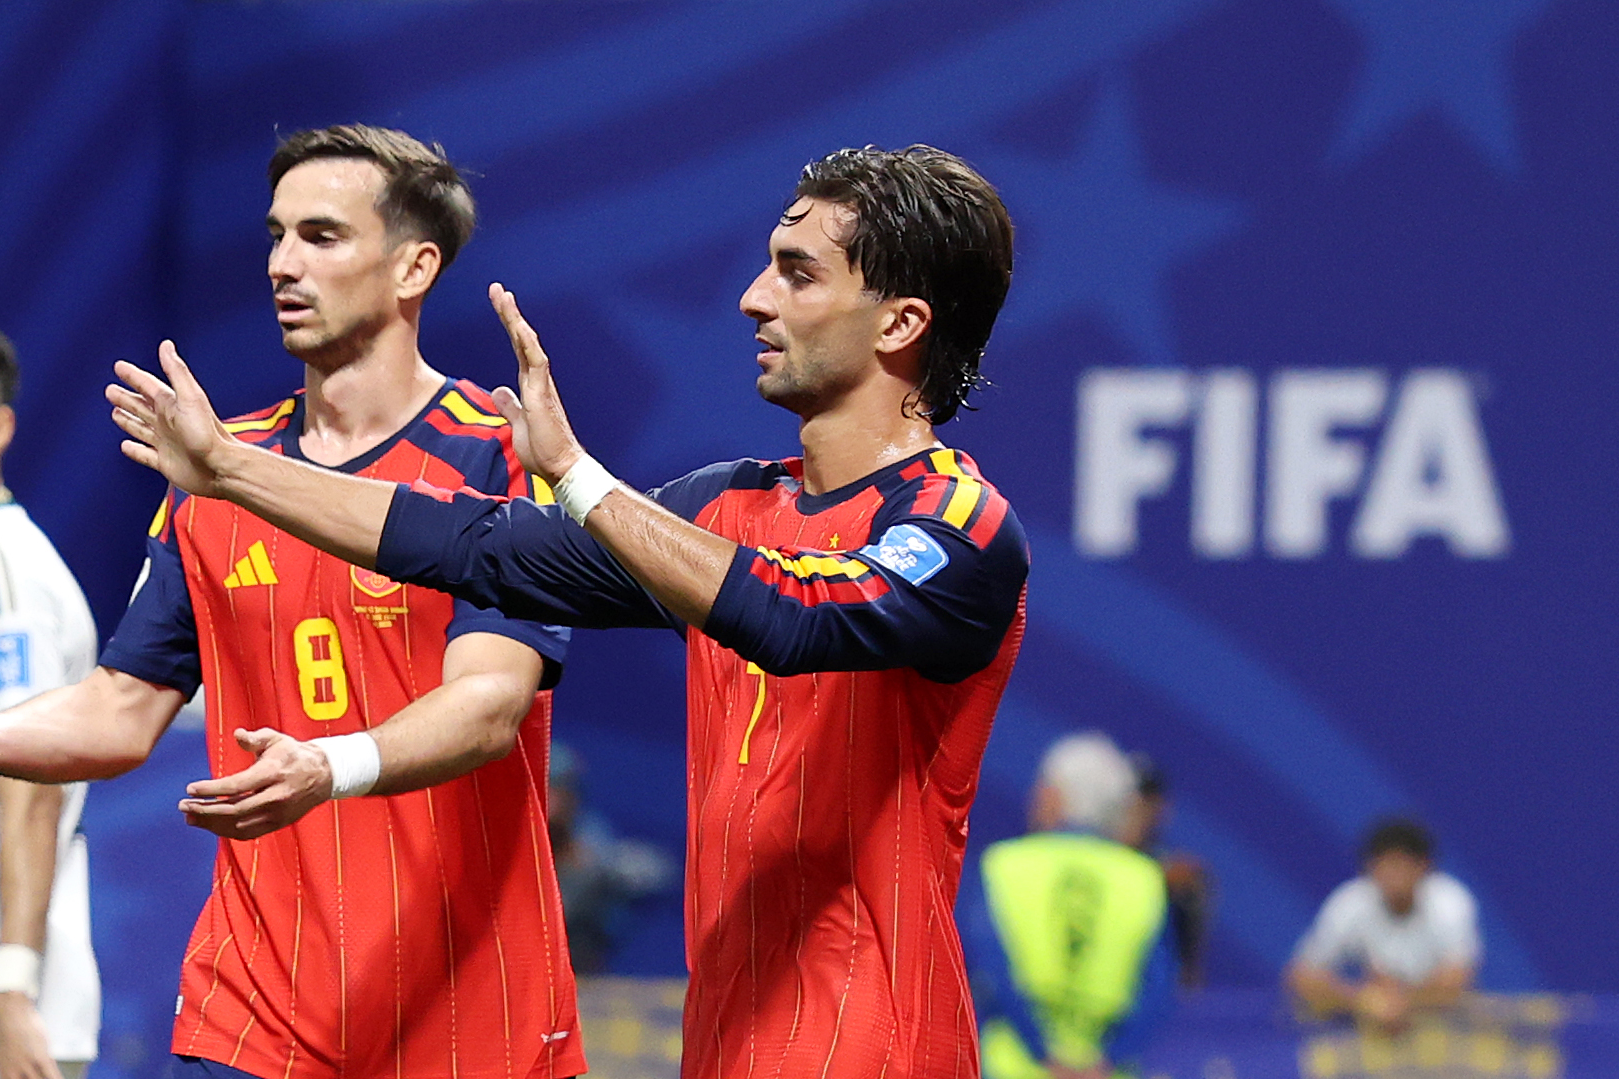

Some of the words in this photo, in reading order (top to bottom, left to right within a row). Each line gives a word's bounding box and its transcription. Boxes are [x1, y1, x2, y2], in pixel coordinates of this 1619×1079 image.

[1075, 367, 1511, 558] FIFA
[293, 617, 349, 721] 8
[738, 661, 766, 764] 7
